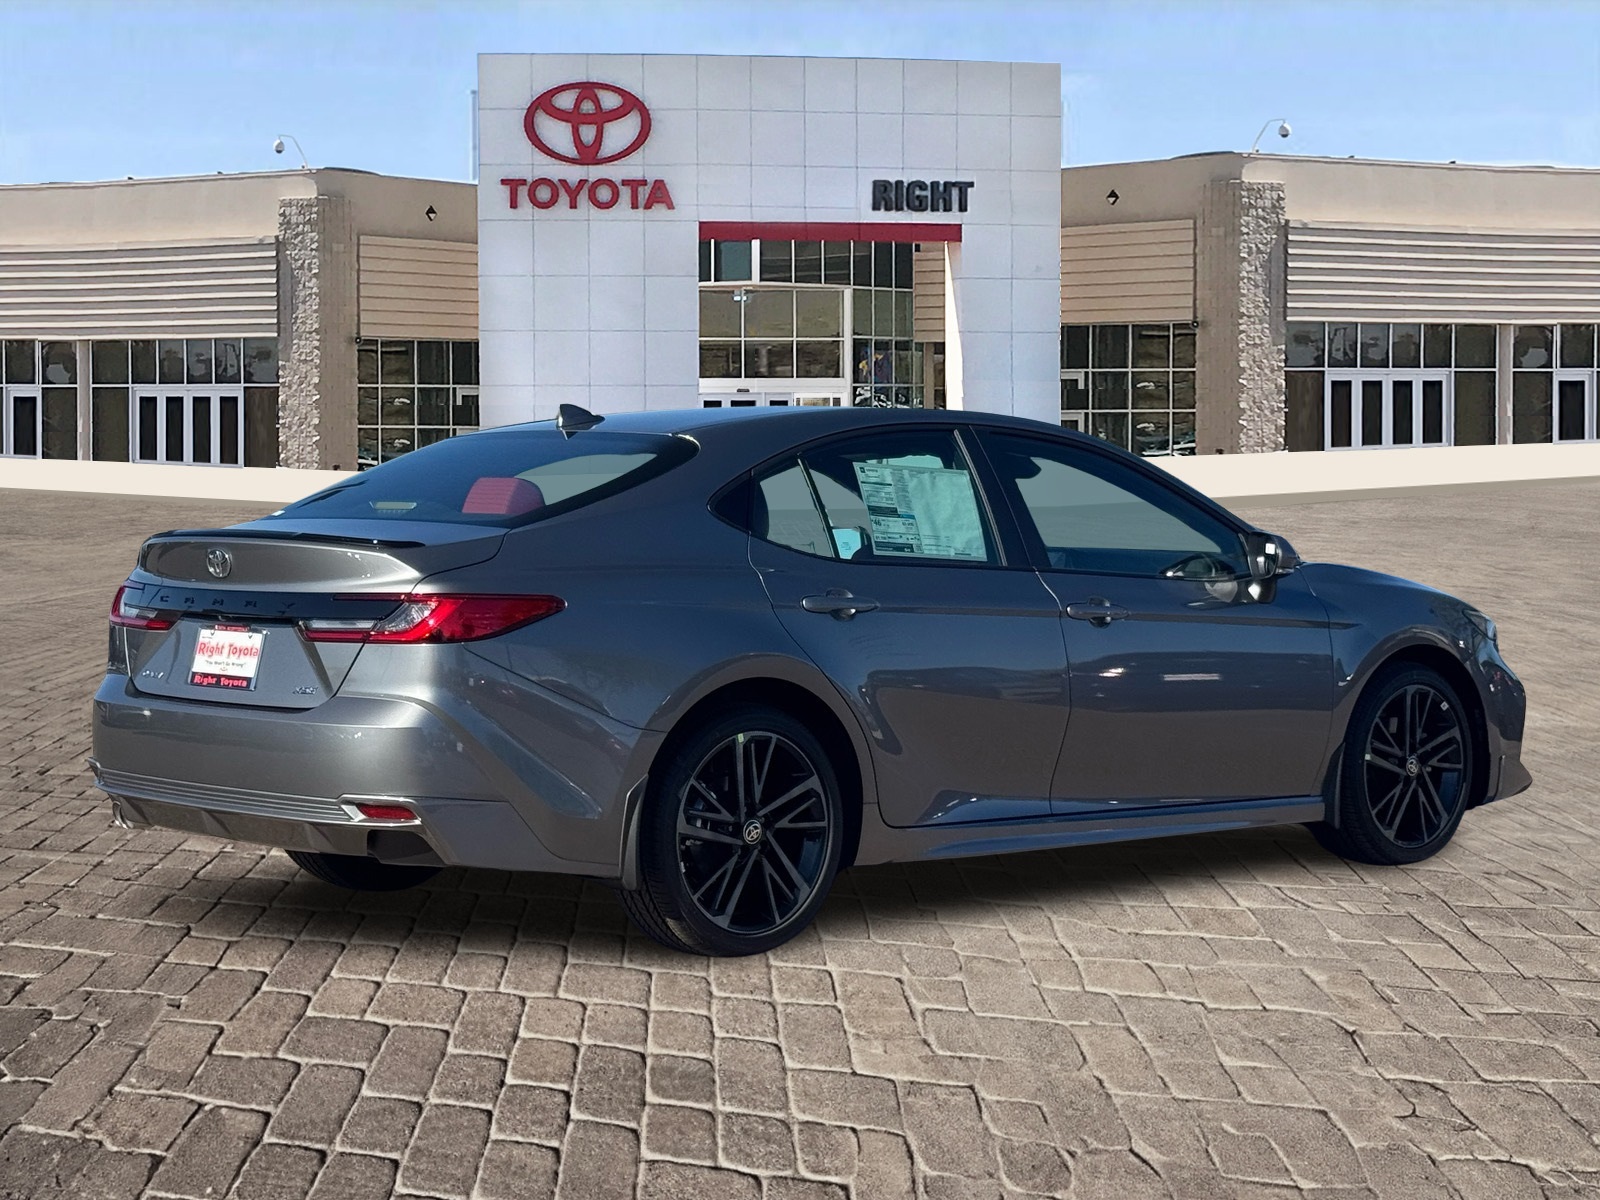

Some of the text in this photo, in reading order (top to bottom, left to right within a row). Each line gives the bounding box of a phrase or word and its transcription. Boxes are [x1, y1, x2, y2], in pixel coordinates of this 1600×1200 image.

[500, 177, 675, 210] TOYOTA
[872, 180, 974, 212] RIGHT
[198, 642, 259, 659] Right Toyota
[194, 674, 248, 687] Right Toyota
